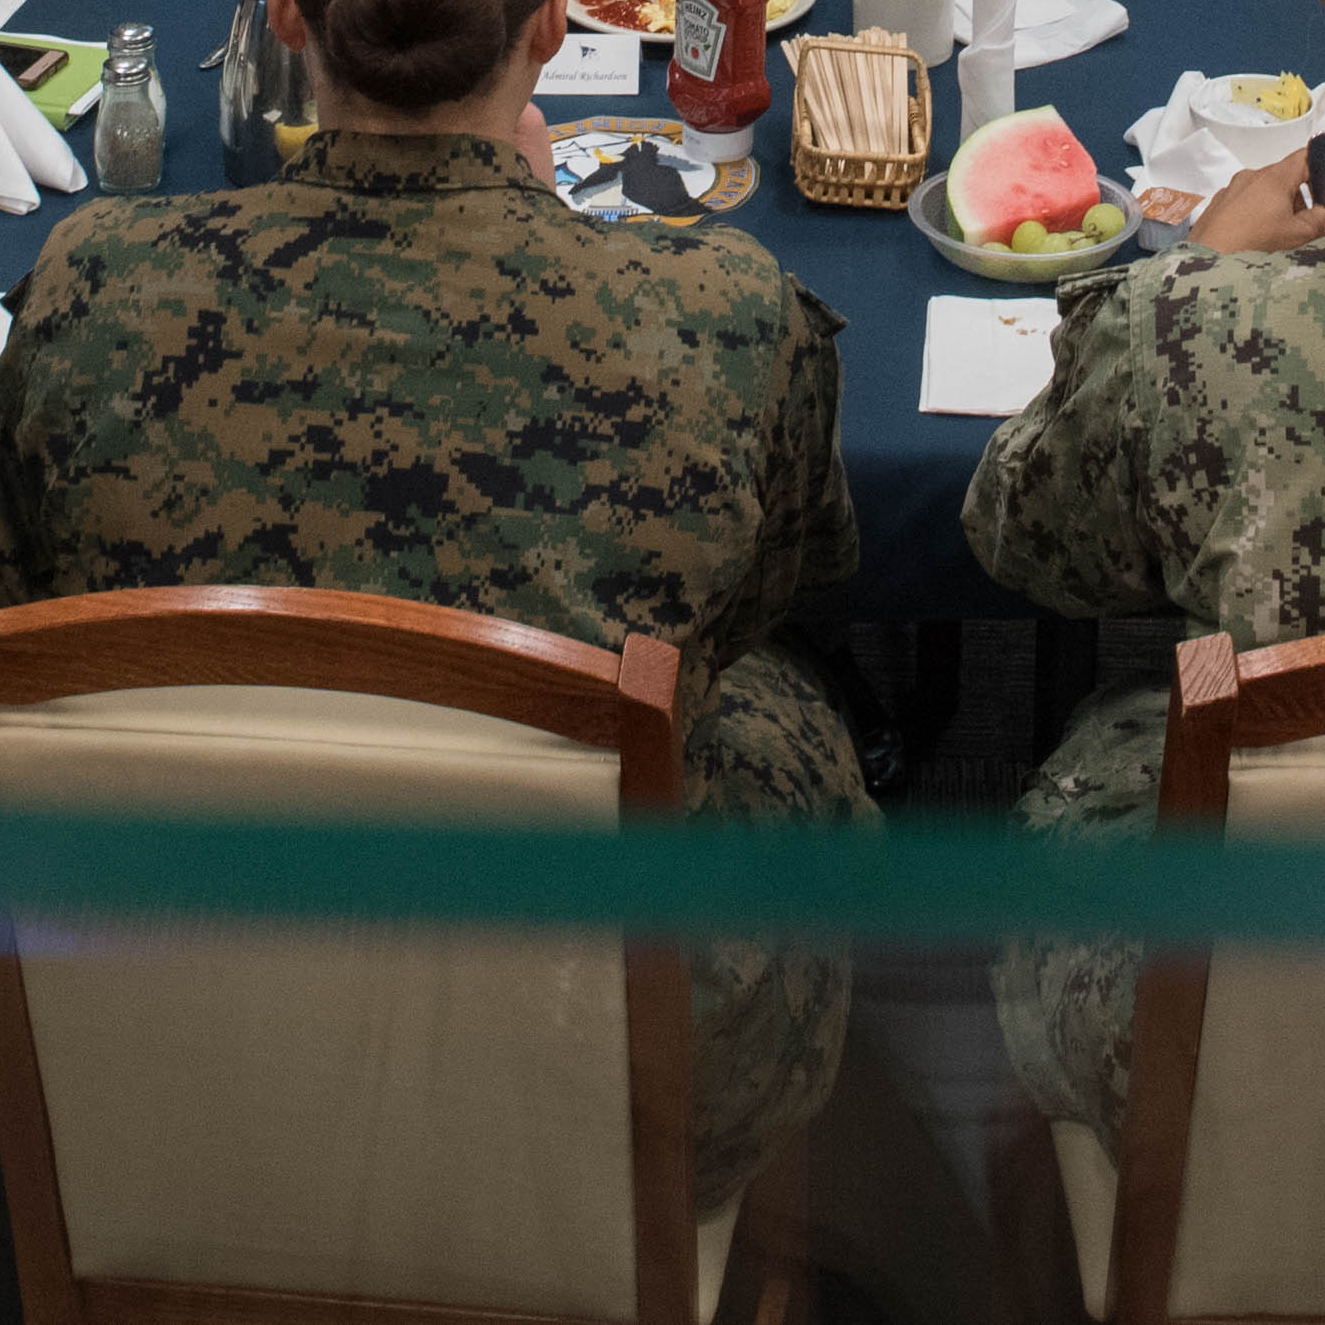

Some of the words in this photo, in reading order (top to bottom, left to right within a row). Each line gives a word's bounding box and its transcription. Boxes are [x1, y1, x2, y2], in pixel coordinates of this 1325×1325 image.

[683, 2, 708, 20] HEINZ
[541, 70, 577, 81] Admiral
[580, 70, 628, 82] Richardson
